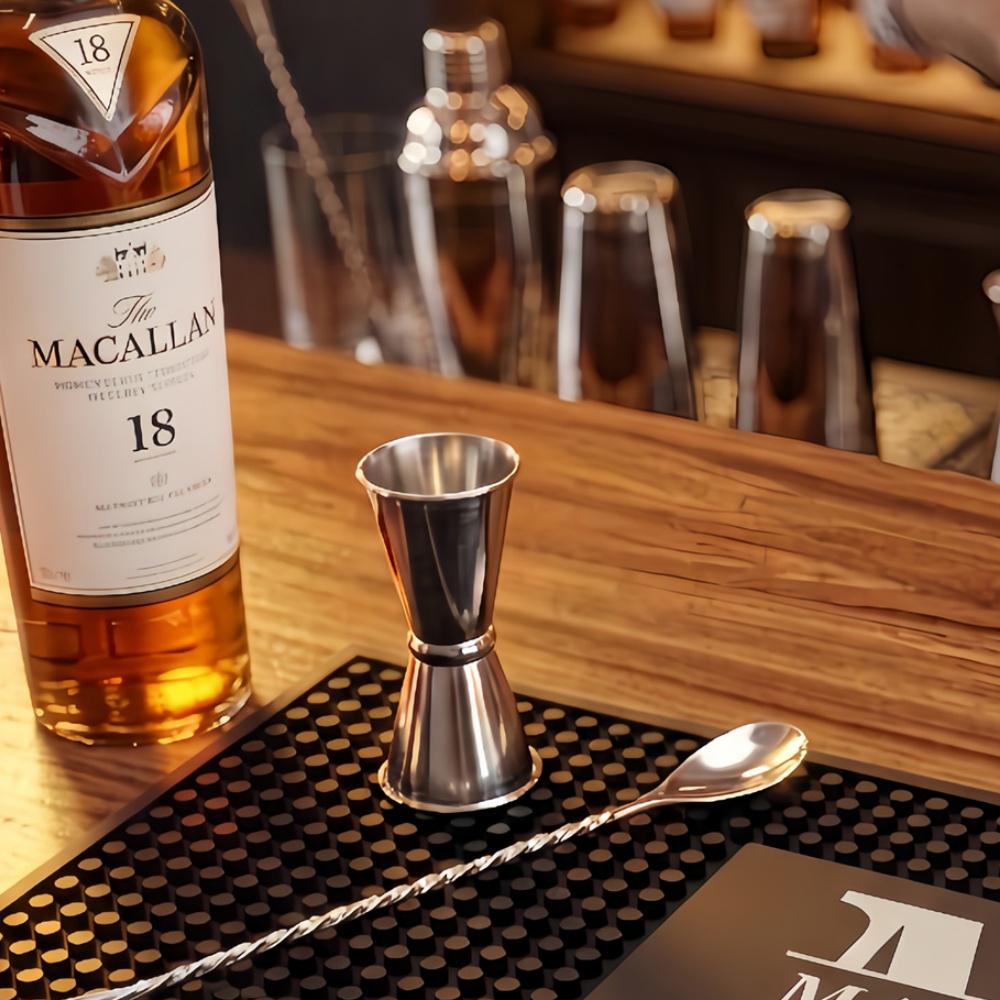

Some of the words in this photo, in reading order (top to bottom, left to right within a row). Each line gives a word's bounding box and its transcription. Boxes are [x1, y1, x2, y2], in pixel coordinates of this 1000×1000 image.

[74, 34, 110, 65] 18
[27, 298, 216, 368] MACALLAN
[127, 408, 176, 452] 18
